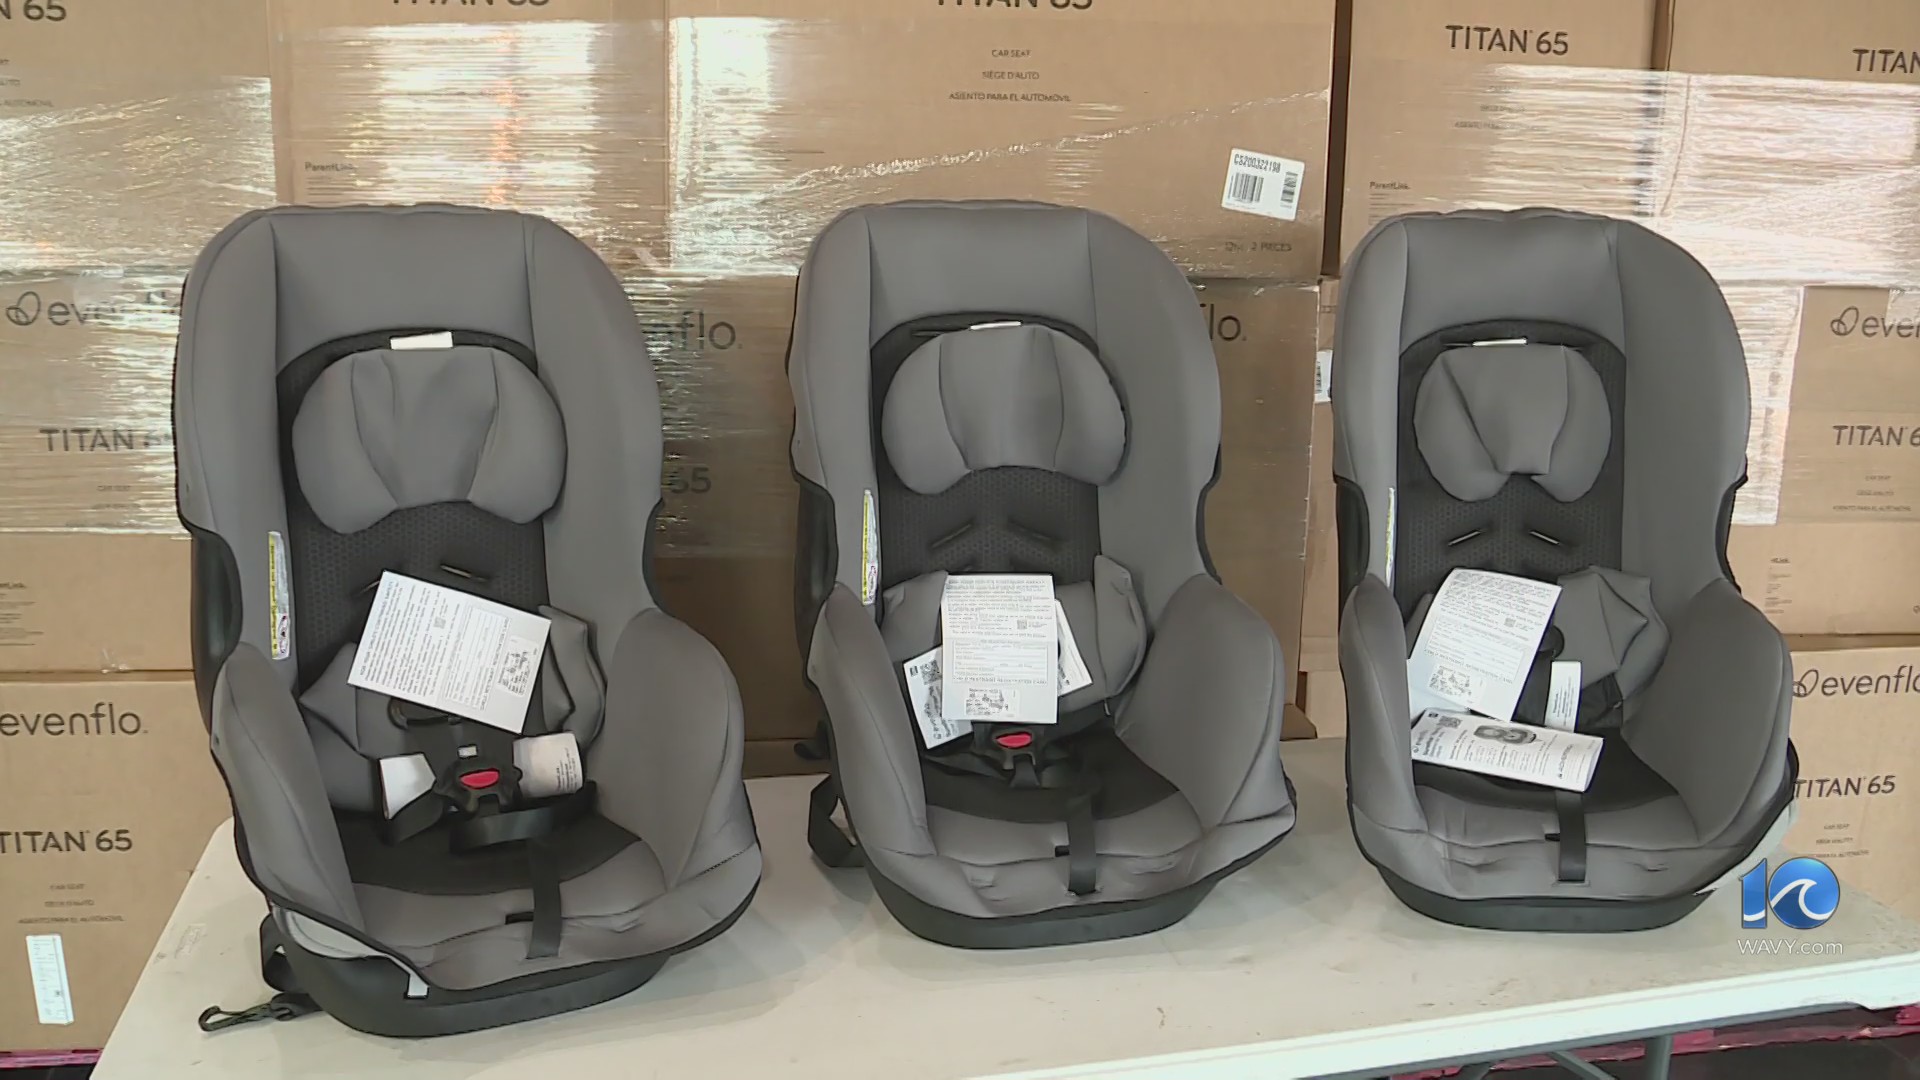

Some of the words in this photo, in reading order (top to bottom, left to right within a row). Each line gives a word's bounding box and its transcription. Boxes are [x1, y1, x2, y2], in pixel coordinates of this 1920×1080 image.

[1445, 25, 1529, 53] TITAN
[1536, 31, 1569, 56] 65
[991, 49, 1009, 58] CAR
[39, 427, 134, 452] TITAN
[1832, 424, 1904, 446] TITAN
[1867, 775, 1895, 795] 65
[95, 829, 132, 852] 65
